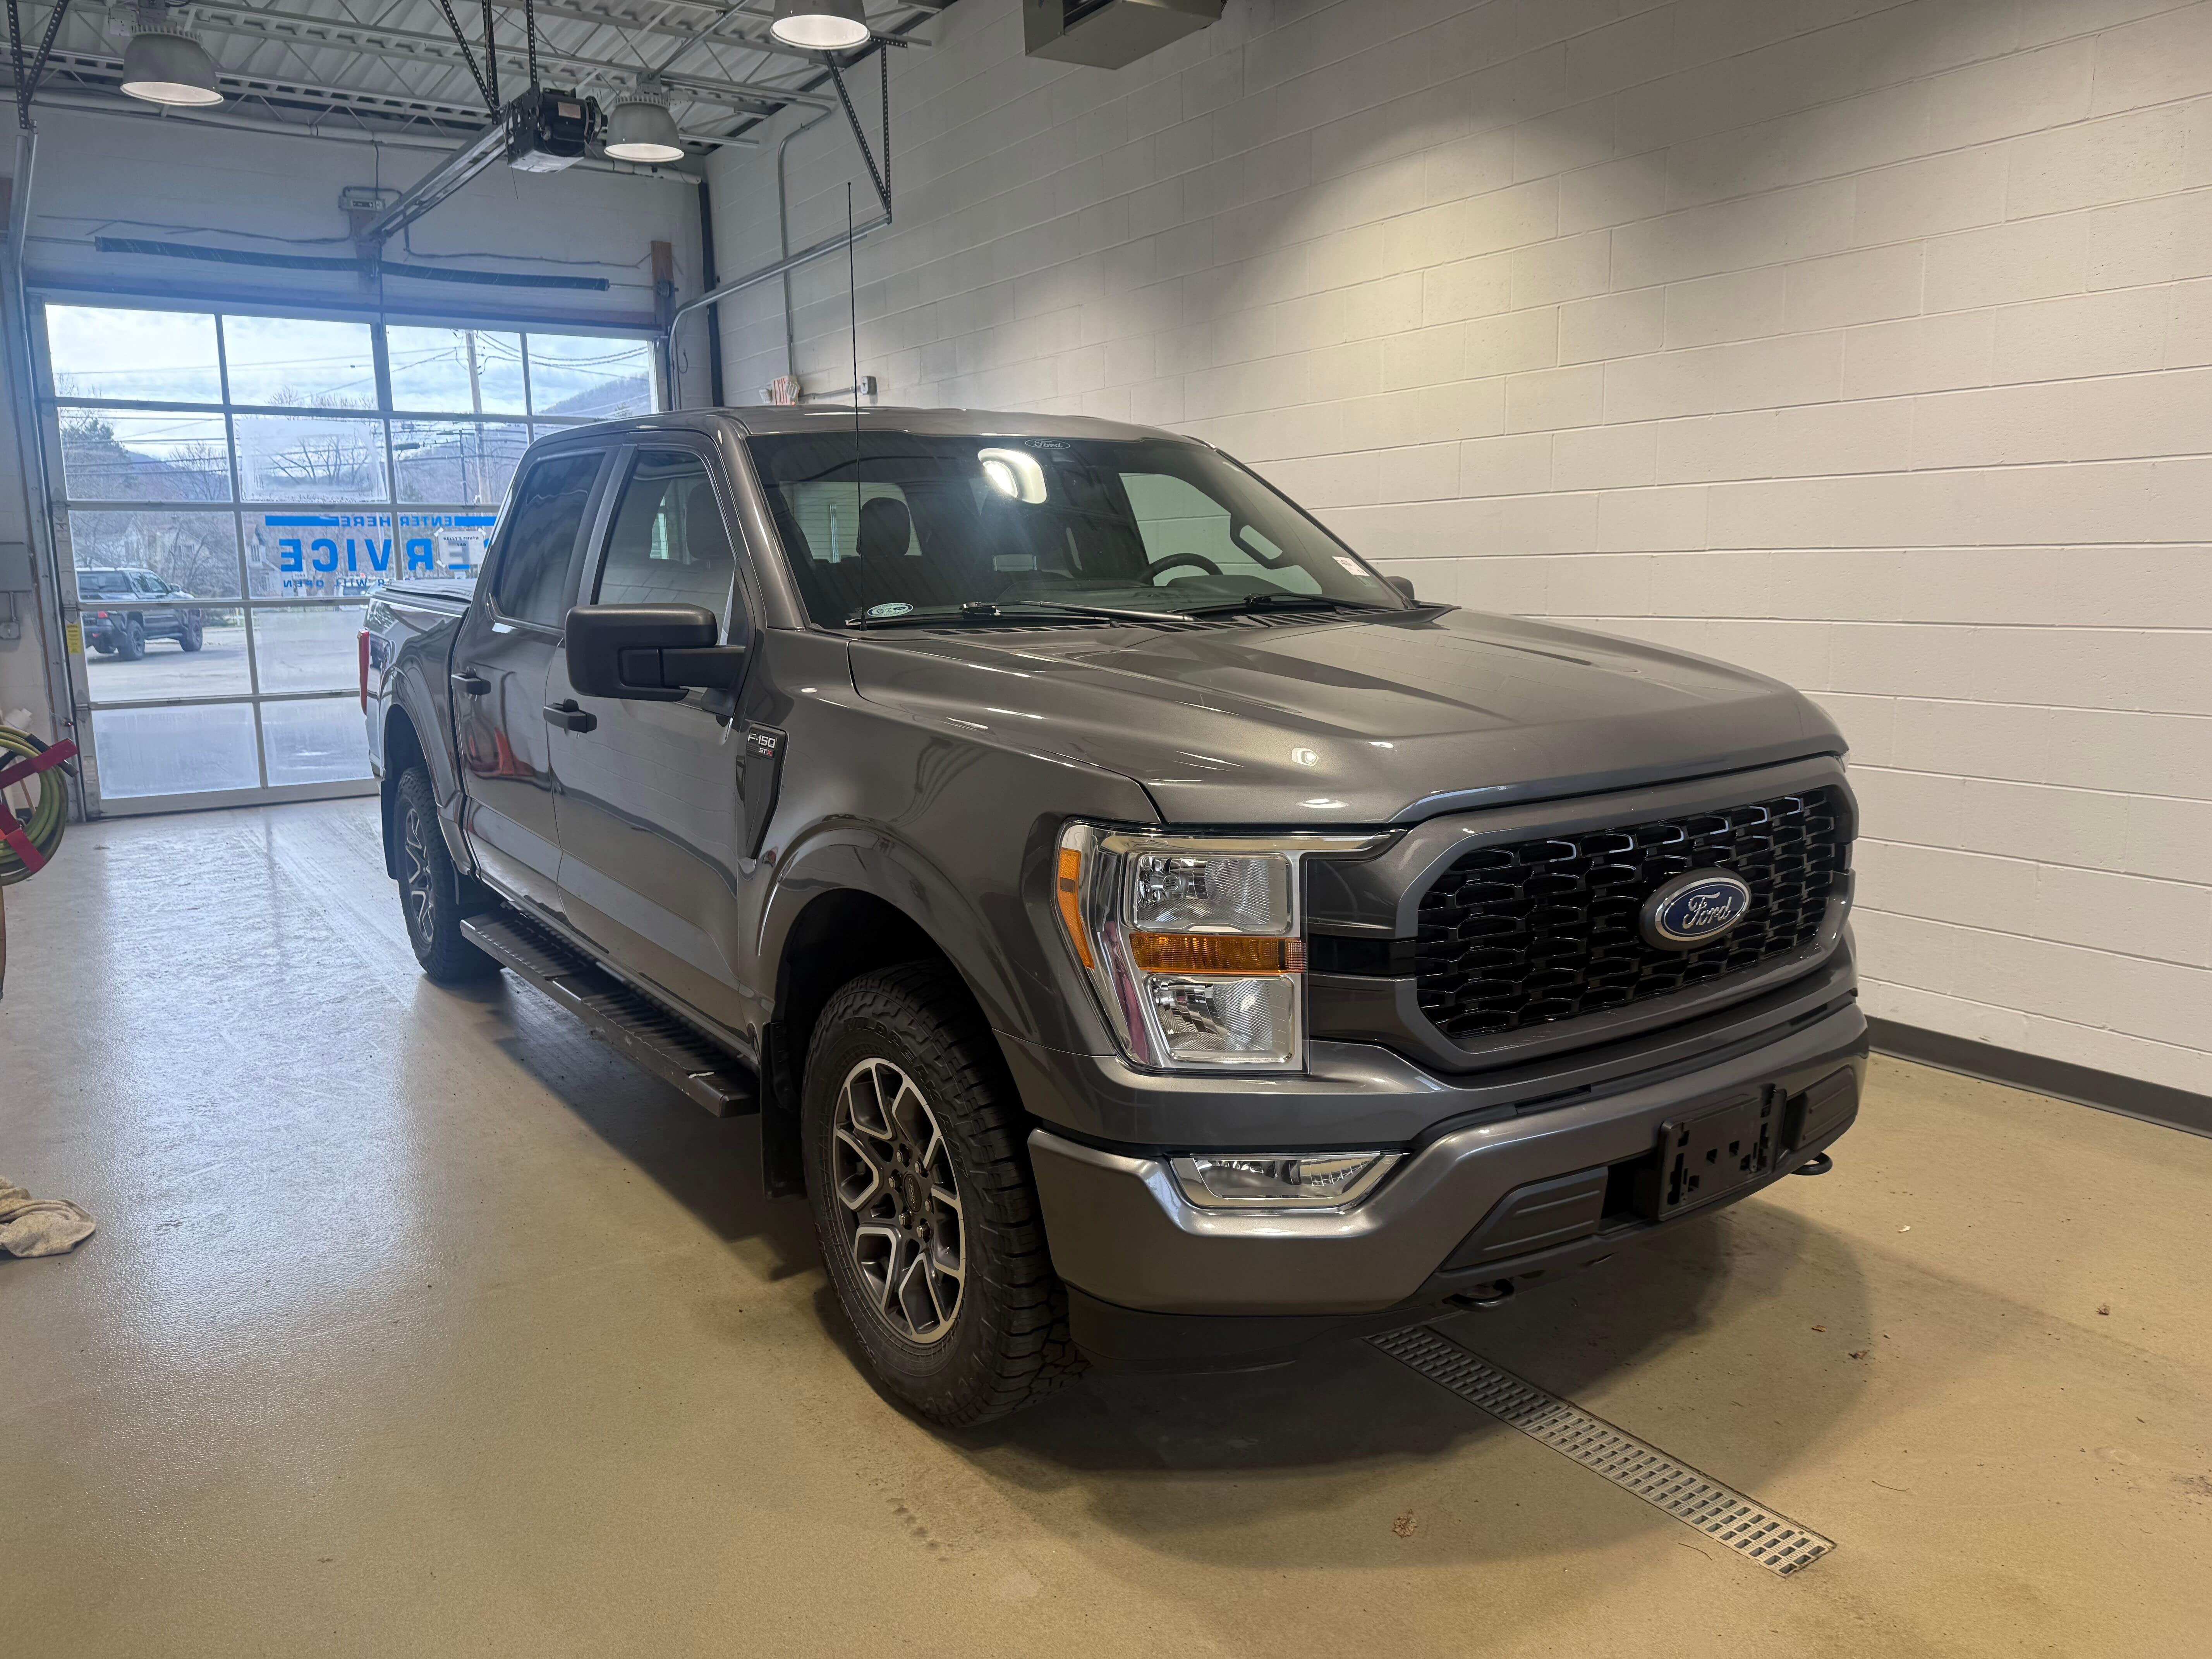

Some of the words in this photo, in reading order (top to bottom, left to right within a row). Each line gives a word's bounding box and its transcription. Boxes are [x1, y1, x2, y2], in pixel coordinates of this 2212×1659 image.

[748, 733, 776, 749] F-150
[758, 747, 773, 757] STX
[1682, 891, 1733, 929] Ford
